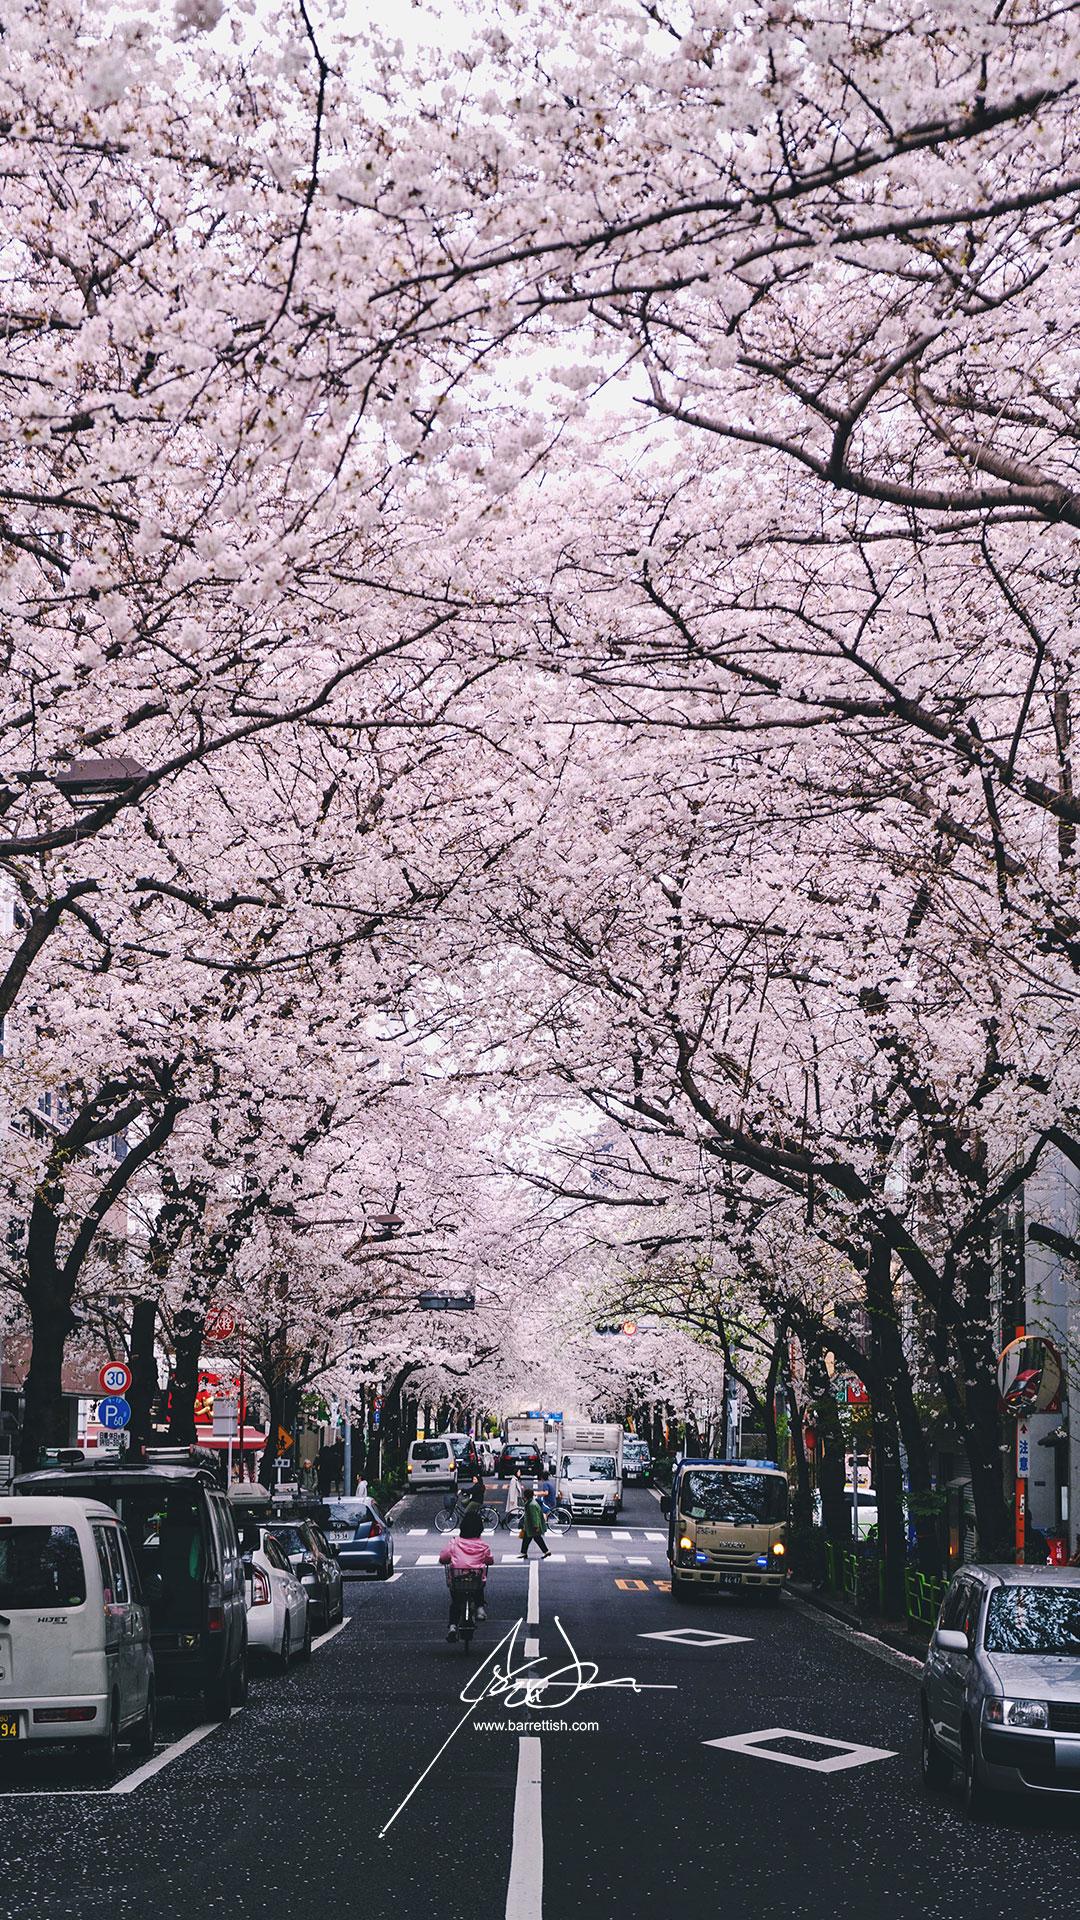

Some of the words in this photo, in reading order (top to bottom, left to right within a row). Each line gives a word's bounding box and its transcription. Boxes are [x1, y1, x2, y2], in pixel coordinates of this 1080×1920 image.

[107, 1371, 125, 1386] 30
[105, 1405, 118, 1425] P
[1019, 1440, 1029, 1472] 注意
[1, 1722, 17, 1737] 94
